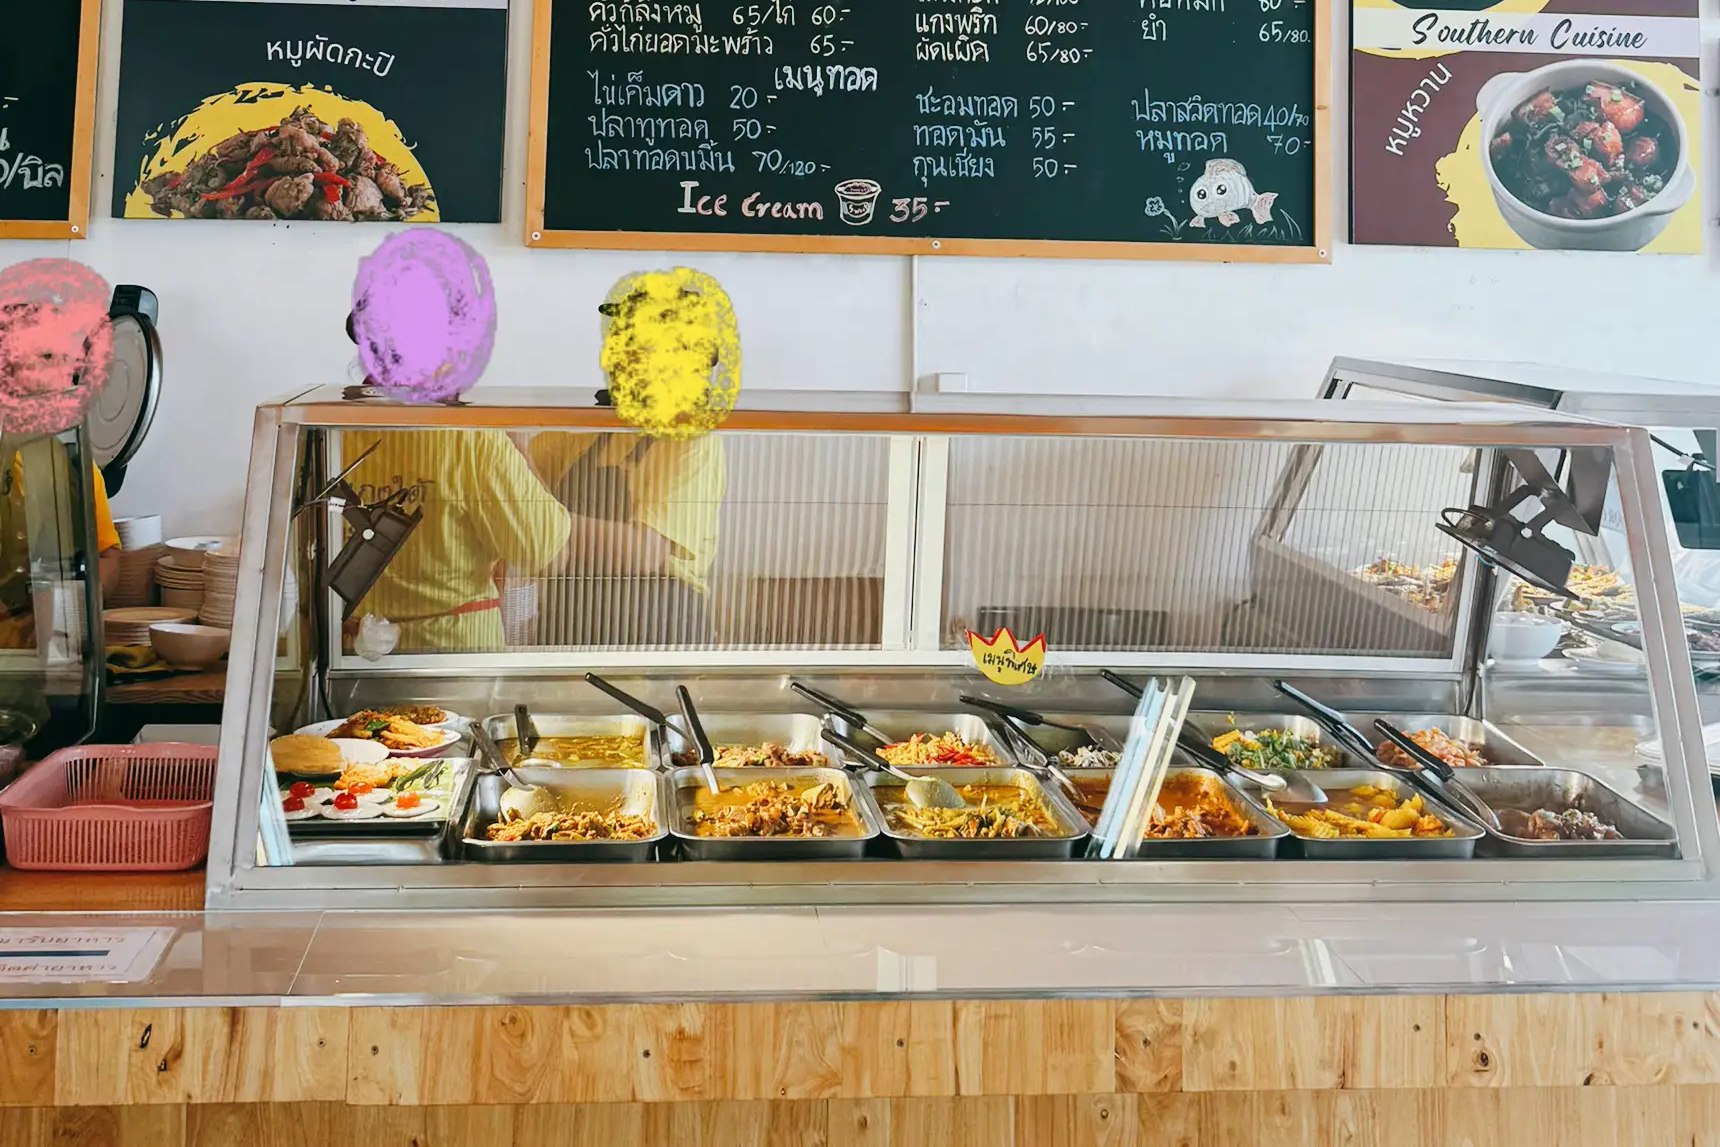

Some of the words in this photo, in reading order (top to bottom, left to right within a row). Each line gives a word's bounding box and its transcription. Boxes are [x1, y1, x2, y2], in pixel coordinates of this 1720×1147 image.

[916, 6, 997, 34] แกงพริก
[1142, 13, 1166, 40] ยำ
[1412, 13, 1538, 47] Southern
[1550, 19, 1647, 50] Cuisine
[266, 33, 396, 78] หมูผัดกะปิ
[587, 70, 704, 107] ไข่เค็มดาว
[775, 65, 877, 97] เมนูทอด
[916, 86, 1017, 117] ชะอมทอด
[1131, 88, 1261, 127] ปลาสลิดทอด
[1385, 62, 1453, 156] หมูหวาน
[587, 107, 710, 146] ปลาทูทอด
[914, 120, 1005, 147] ทอดมัน
[1136, 130, 1227, 163] หมูทอด
[678, 181, 727, 216] Ice
[742, 192, 823, 220] Cream
